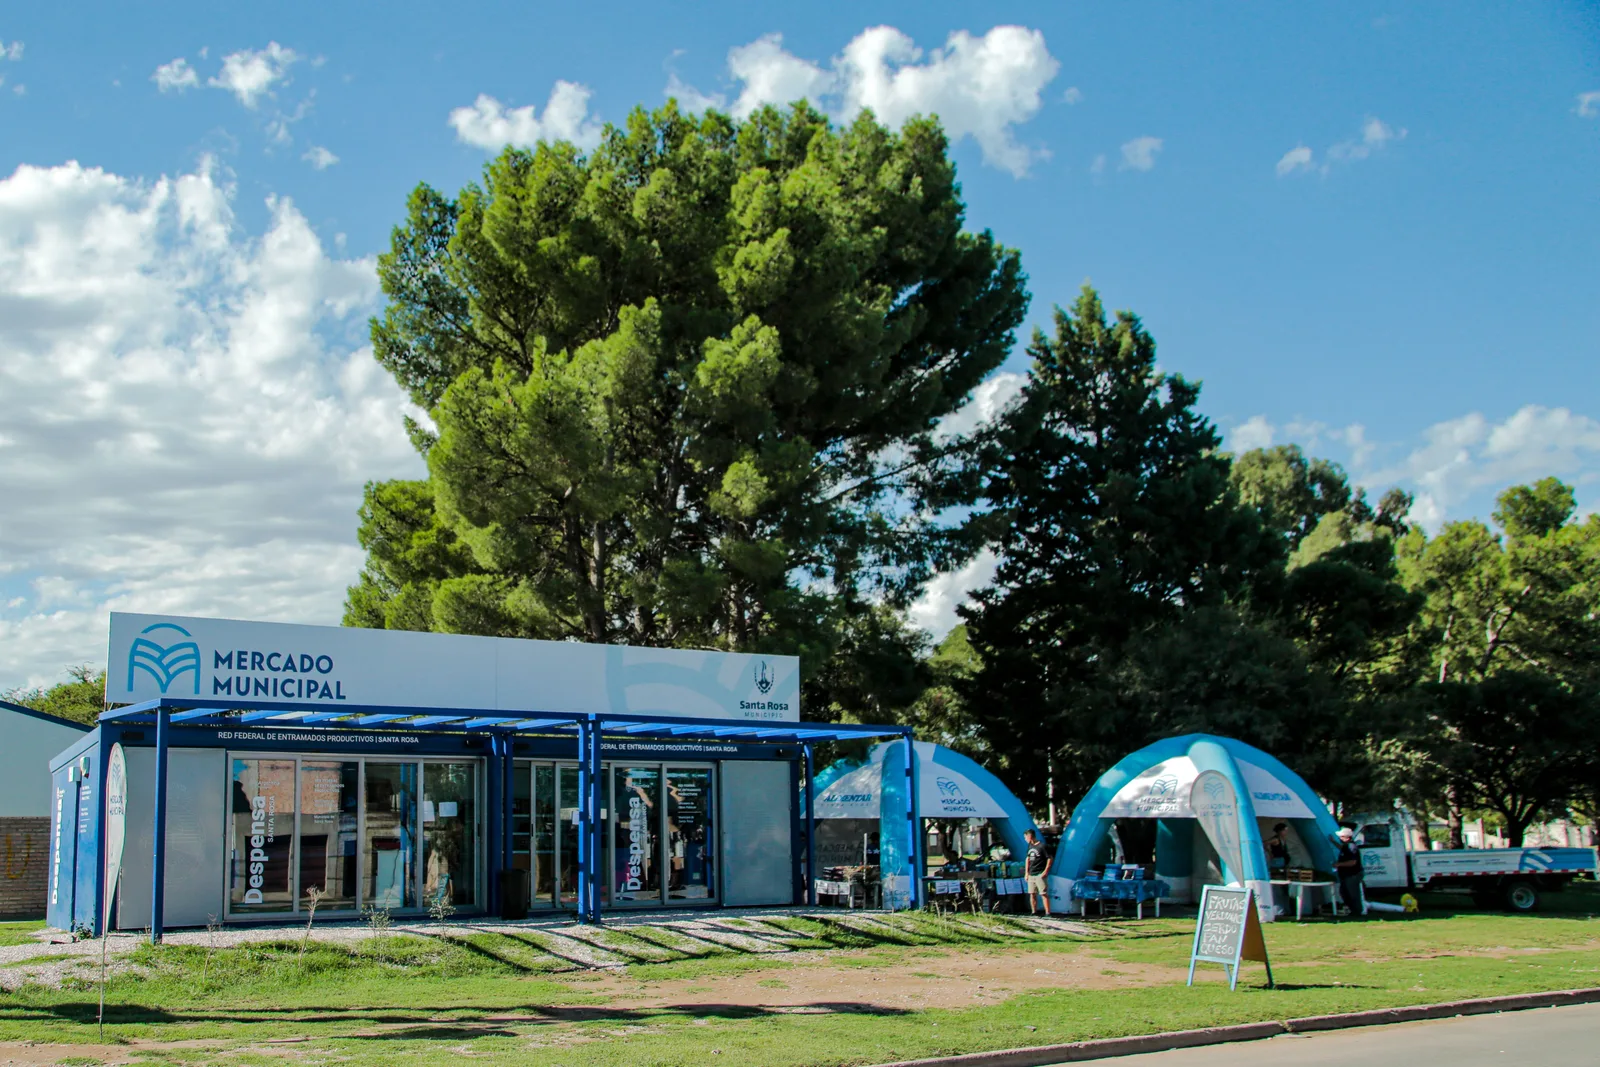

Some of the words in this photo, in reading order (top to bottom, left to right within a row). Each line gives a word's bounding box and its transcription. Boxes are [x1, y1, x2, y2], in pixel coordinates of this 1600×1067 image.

[214, 649, 333, 674] MERCADO
[213, 675, 346, 699] MUNICIPAL
[740, 700, 766, 710] Santa
[767, 701, 789, 711] Rosa
[218, 731, 233, 739] RED
[233, 732, 266, 740] FEDERAL
[266, 732, 277, 741] DE
[277, 733, 326, 742] ENTRAMADOS
[326, 735, 374, 743] PRODUCTIVOS
[626, 743, 665, 751] ENTRAMADOS
[665, 744, 703, 752] PRODUCTIVOS
[1136, 804, 1179, 812] MUNICIPAL
[245, 795, 268, 904] Despensa
[627, 796, 645, 891] Despensa
[1208, 896, 1245, 910] FRUTAS
[1203, 923, 1237, 934] CERDO
[1203, 933, 1228, 944] PAN
[1200, 943, 1234, 955] QUESO
